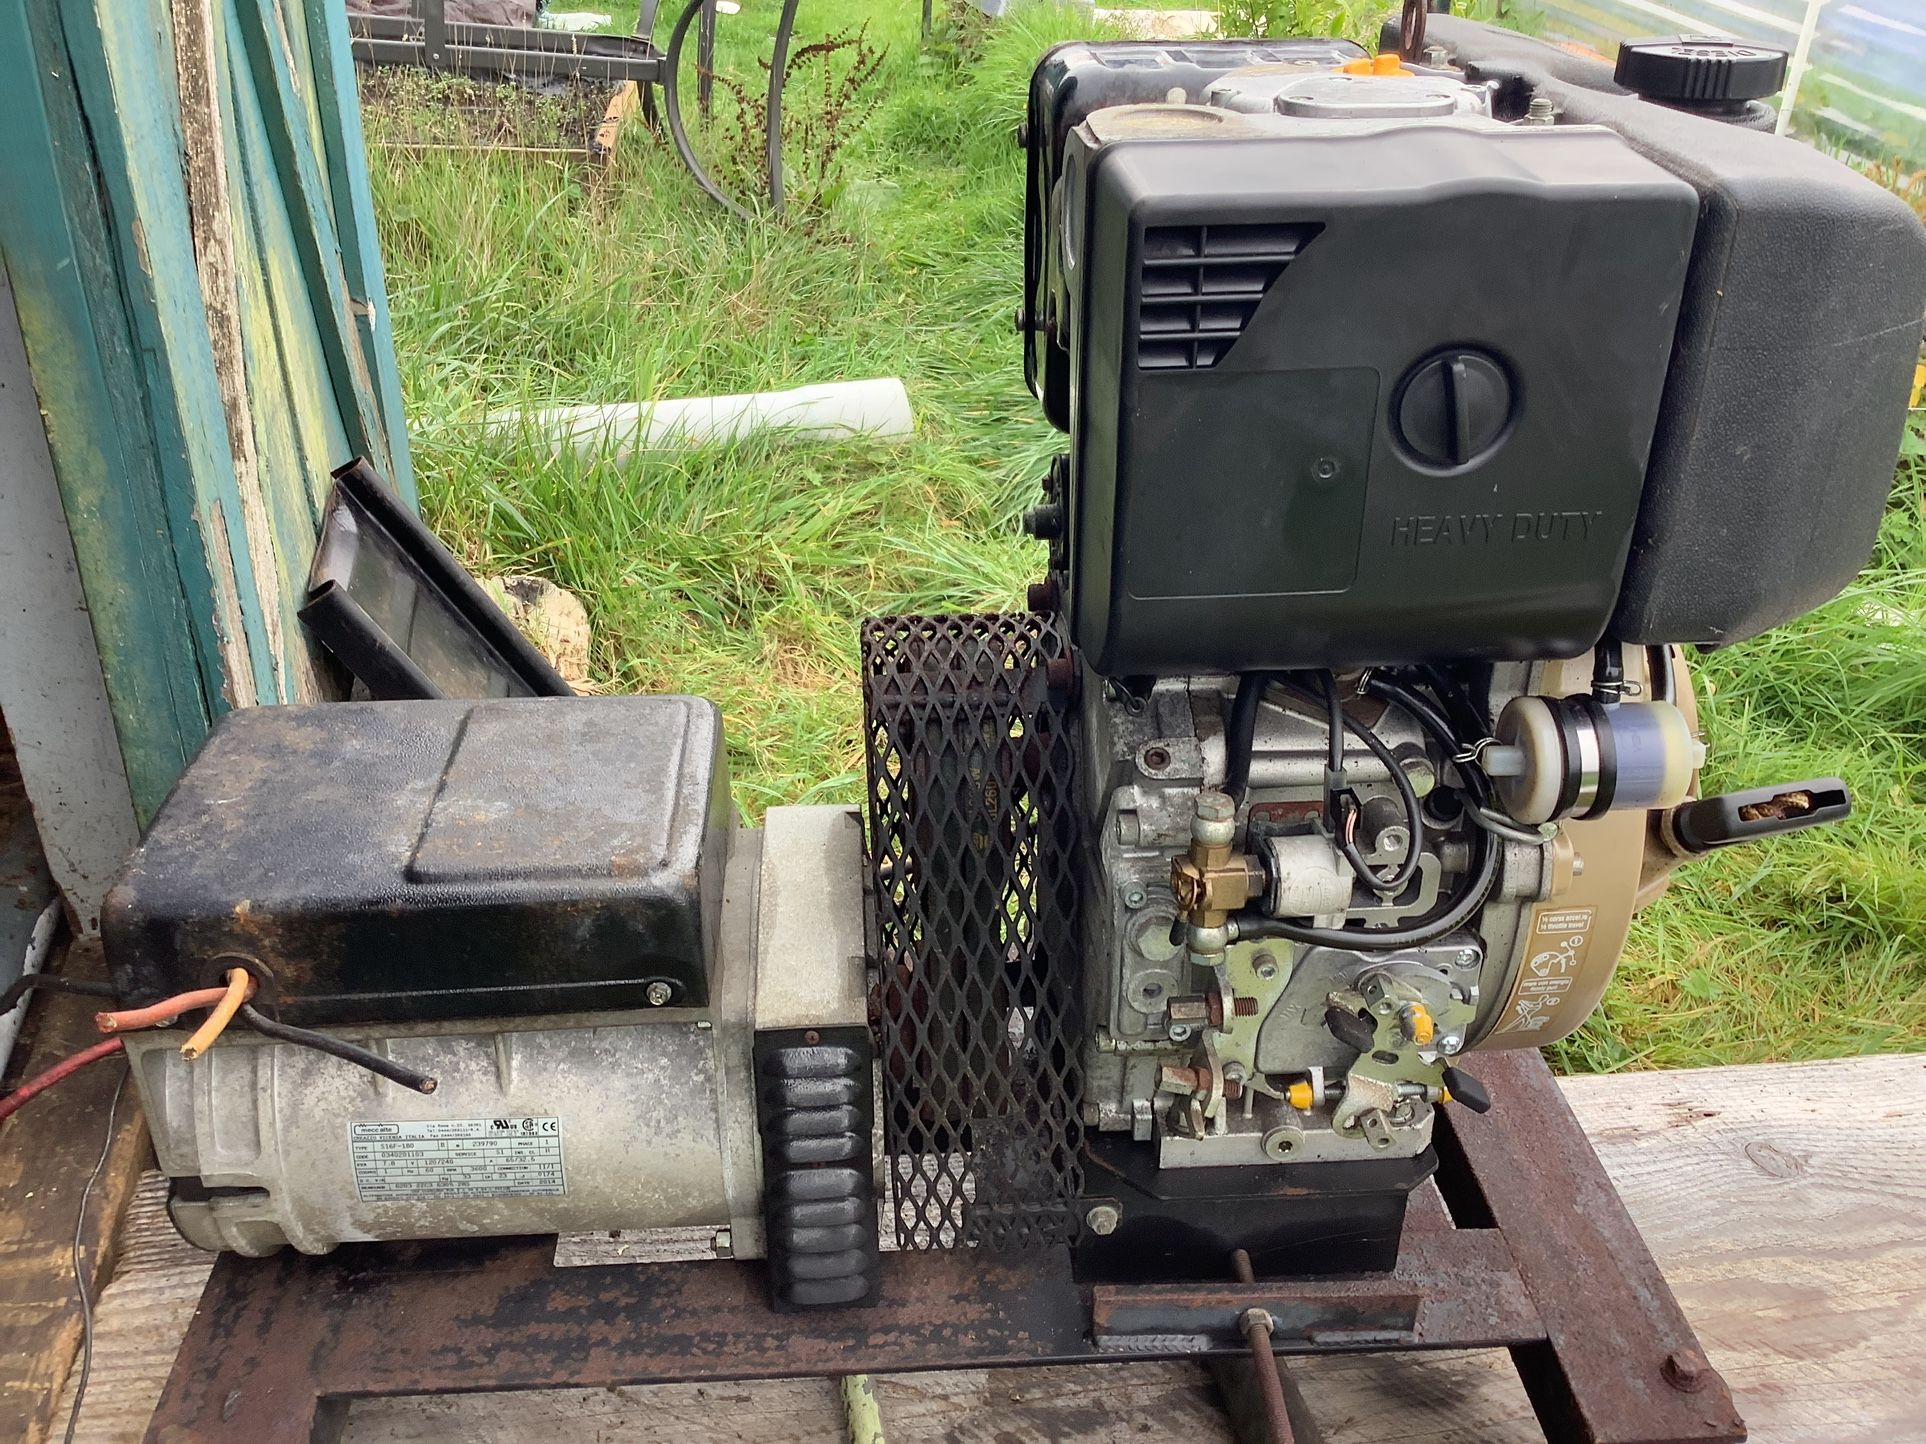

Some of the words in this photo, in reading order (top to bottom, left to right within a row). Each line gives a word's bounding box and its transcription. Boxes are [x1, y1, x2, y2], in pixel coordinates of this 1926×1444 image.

[1671, 47, 1757, 57] DIESEL
[1391, 514, 1503, 545] HEAVY
[1511, 511, 1602, 542] DUTY
[542, 1121, 557, 1131] CE
